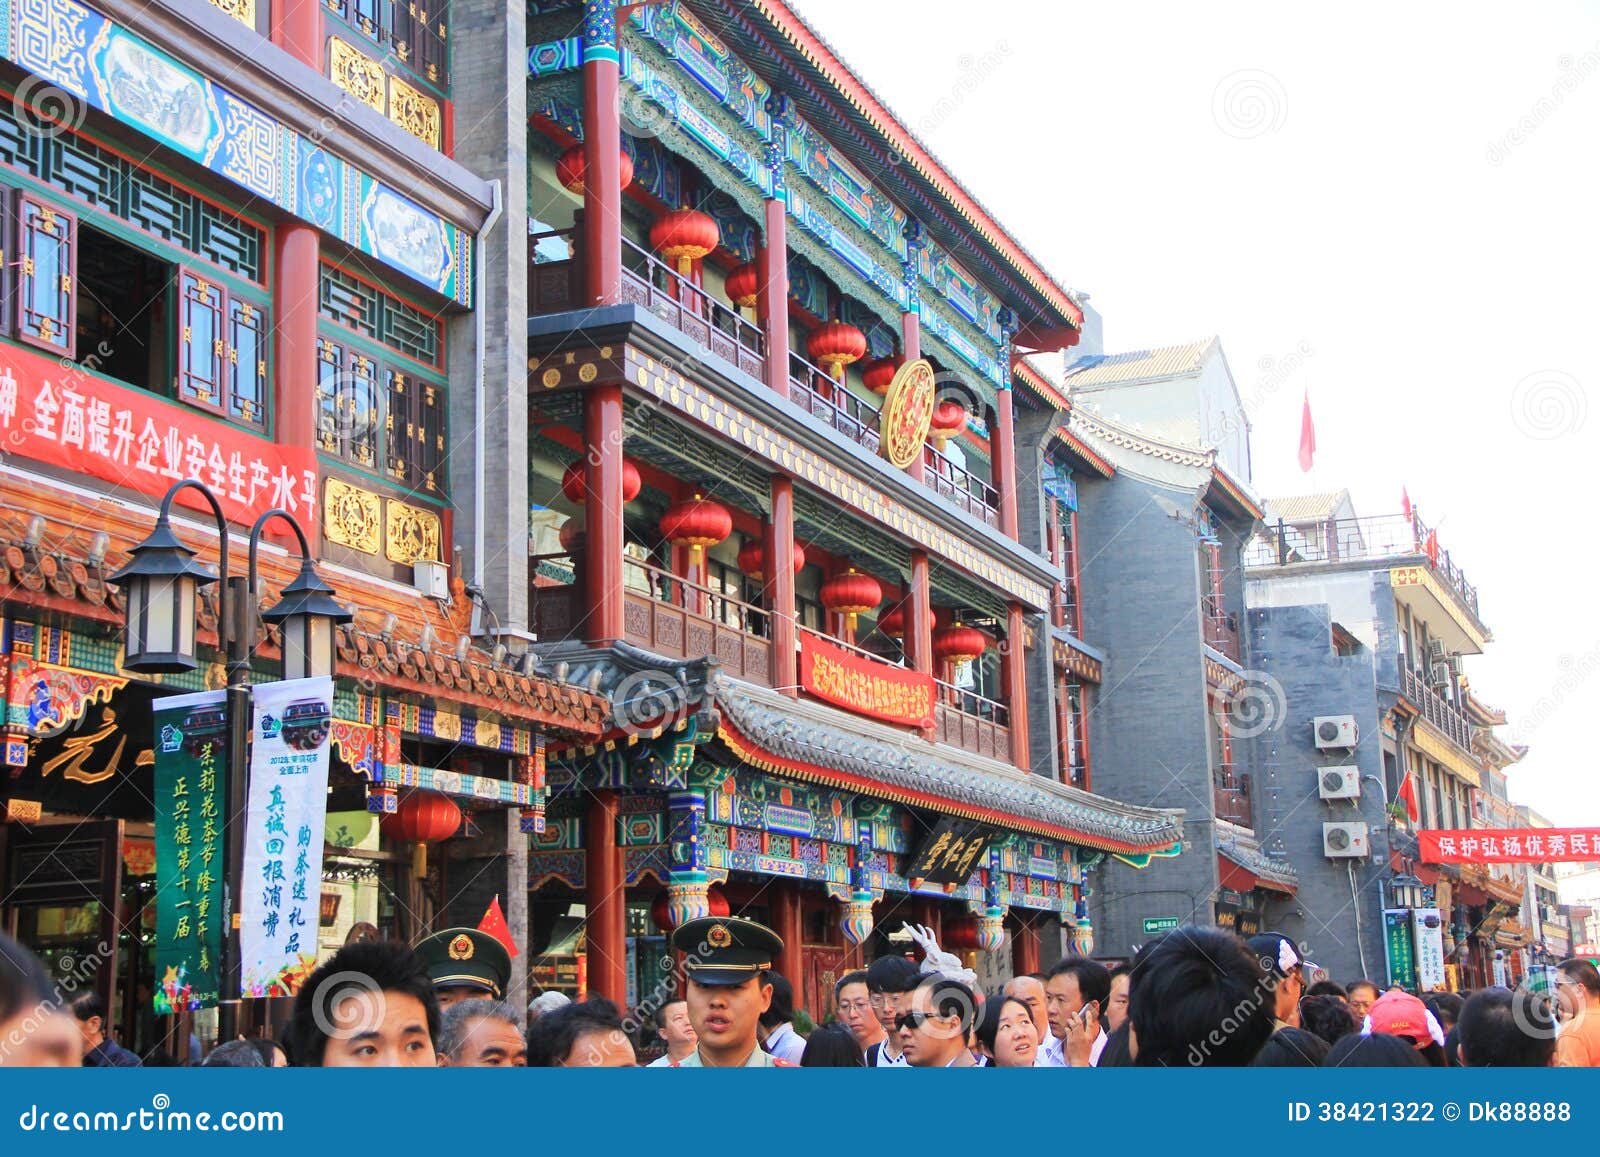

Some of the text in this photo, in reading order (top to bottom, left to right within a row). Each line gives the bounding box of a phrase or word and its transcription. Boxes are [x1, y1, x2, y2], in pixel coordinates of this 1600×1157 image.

[34, 380, 316, 521] 全面提升企业安全生产水平
[172, 776, 192, 941] 正兴德第十一届
[261, 784, 288, 938] 真诚回报消费
[284, 825, 312, 954] 购茶送礼品
